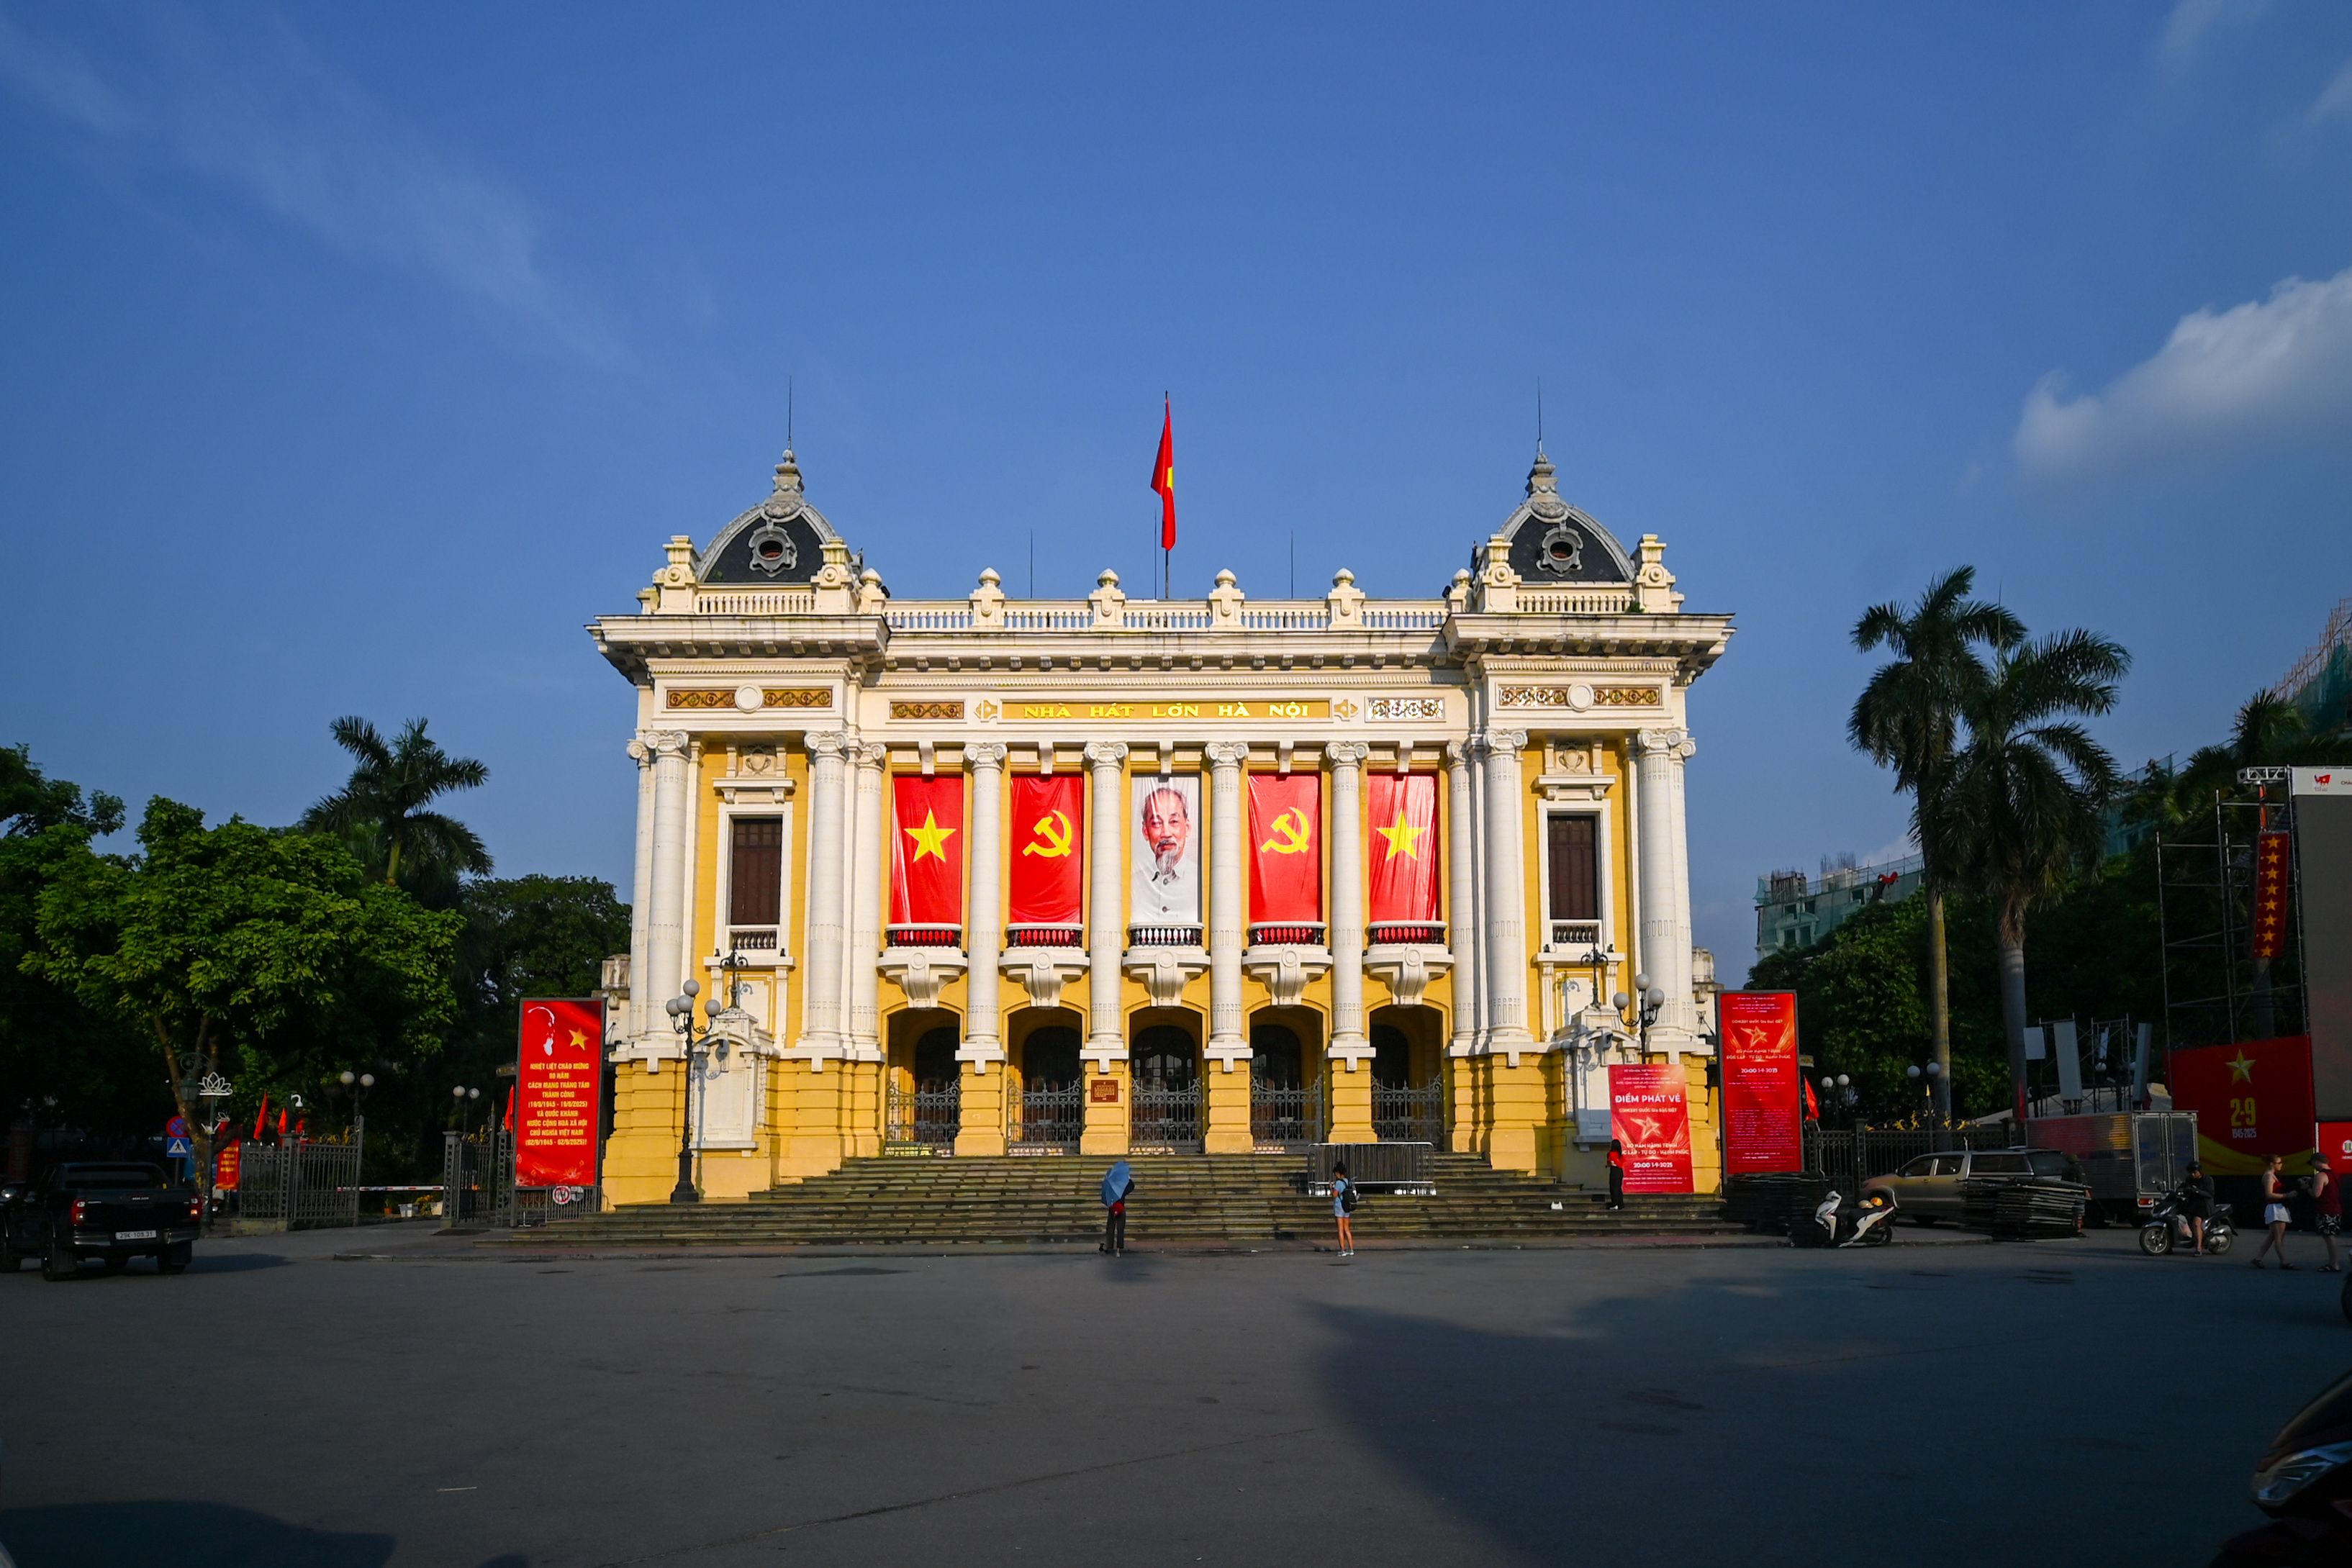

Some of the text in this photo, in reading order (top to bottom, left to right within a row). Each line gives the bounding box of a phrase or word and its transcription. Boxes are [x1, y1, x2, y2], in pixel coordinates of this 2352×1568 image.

[1024, 702, 1308, 719] NHÀ HÁT LỚN HÀ NỘI
[1615, 1092, 1681, 1102] ĐIỂM PHÁT VÉ
